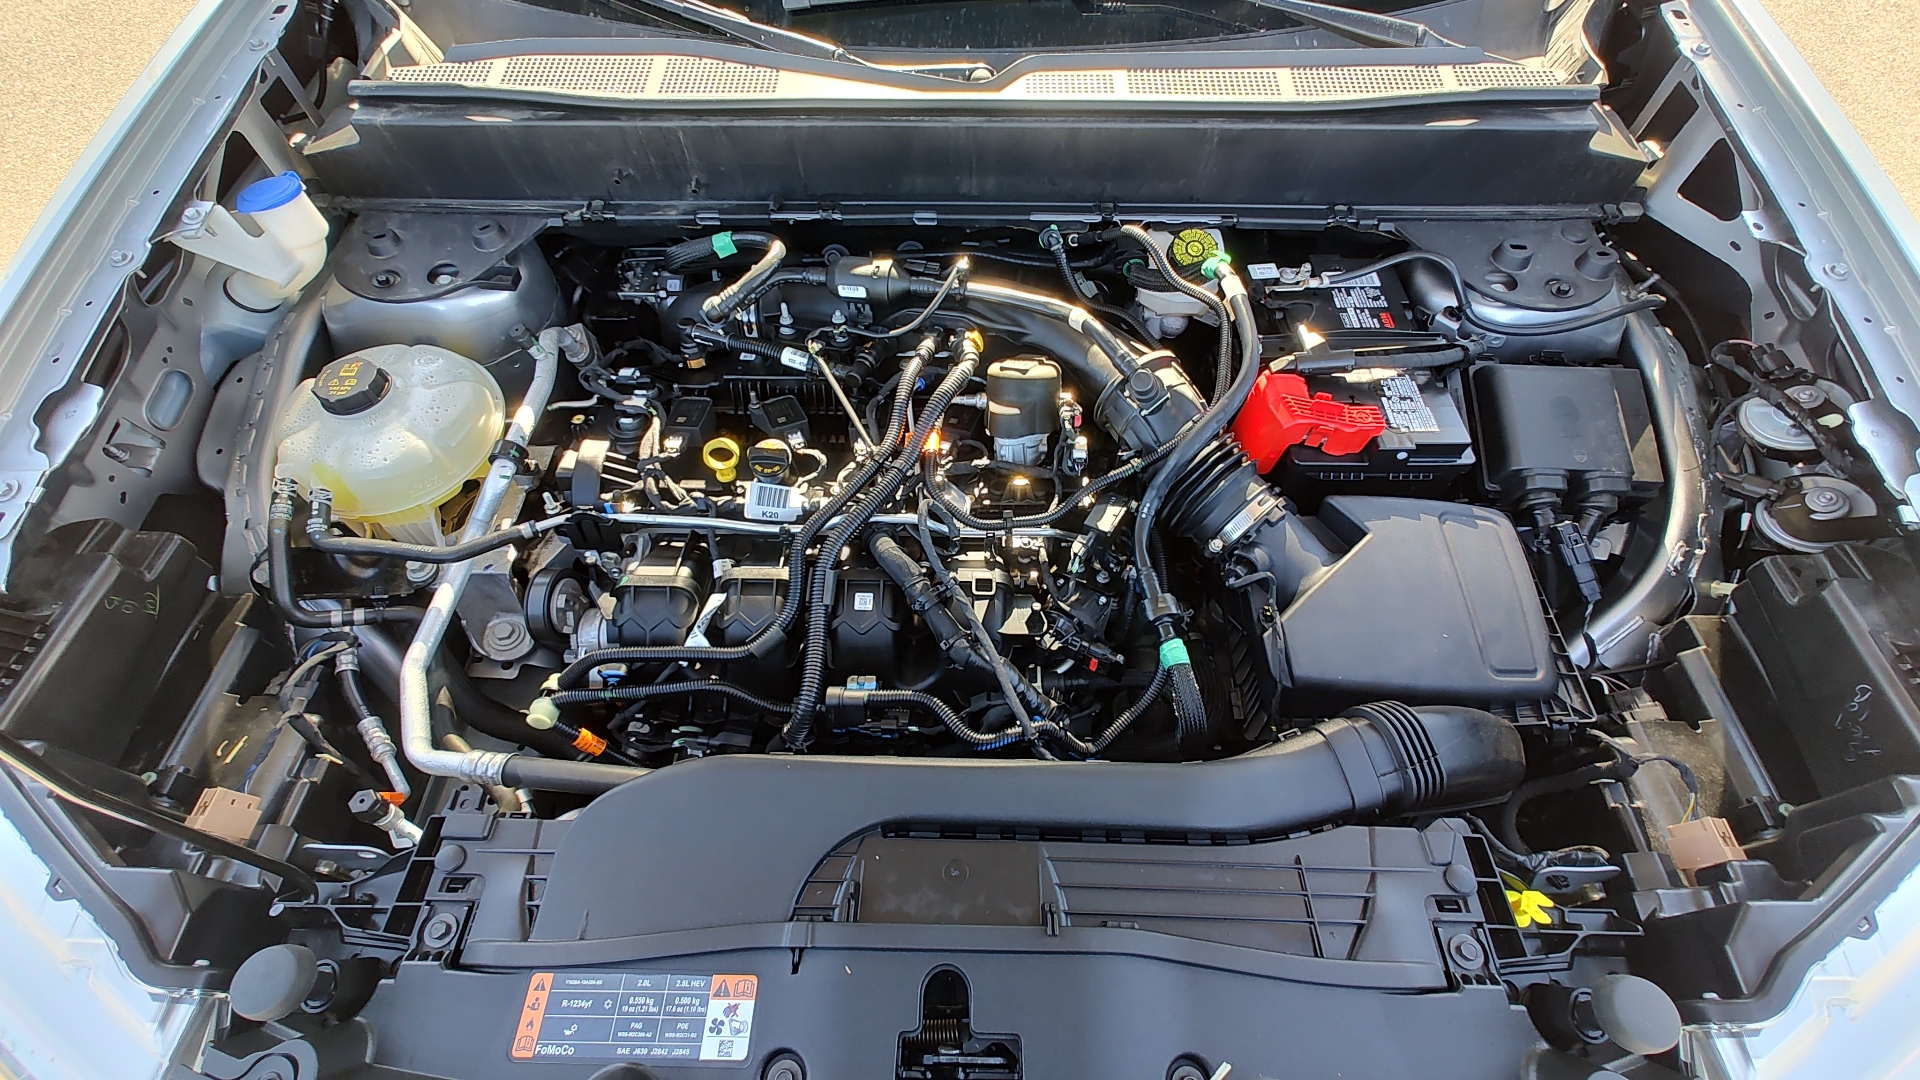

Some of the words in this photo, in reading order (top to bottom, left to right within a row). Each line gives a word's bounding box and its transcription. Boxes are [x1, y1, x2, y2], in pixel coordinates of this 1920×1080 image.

[761, 510, 779, 519] K20
[637, 979, 652, 987] 2.0L
[690, 979, 706, 988] HEV
[561, 1000, 593, 1009] R-1234yf
[628, 996, 646, 1005] 0.550
[645, 996, 655, 1006] kg
[691, 996, 701, 1006] kg
[621, 1005, 629, 1013] 19
[630, 1021, 643, 1029] PAG
[676, 1022, 690, 1030] POE
[535, 1044, 575, 1055] FoMoCo
[616, 1047, 631, 1055] SAE
